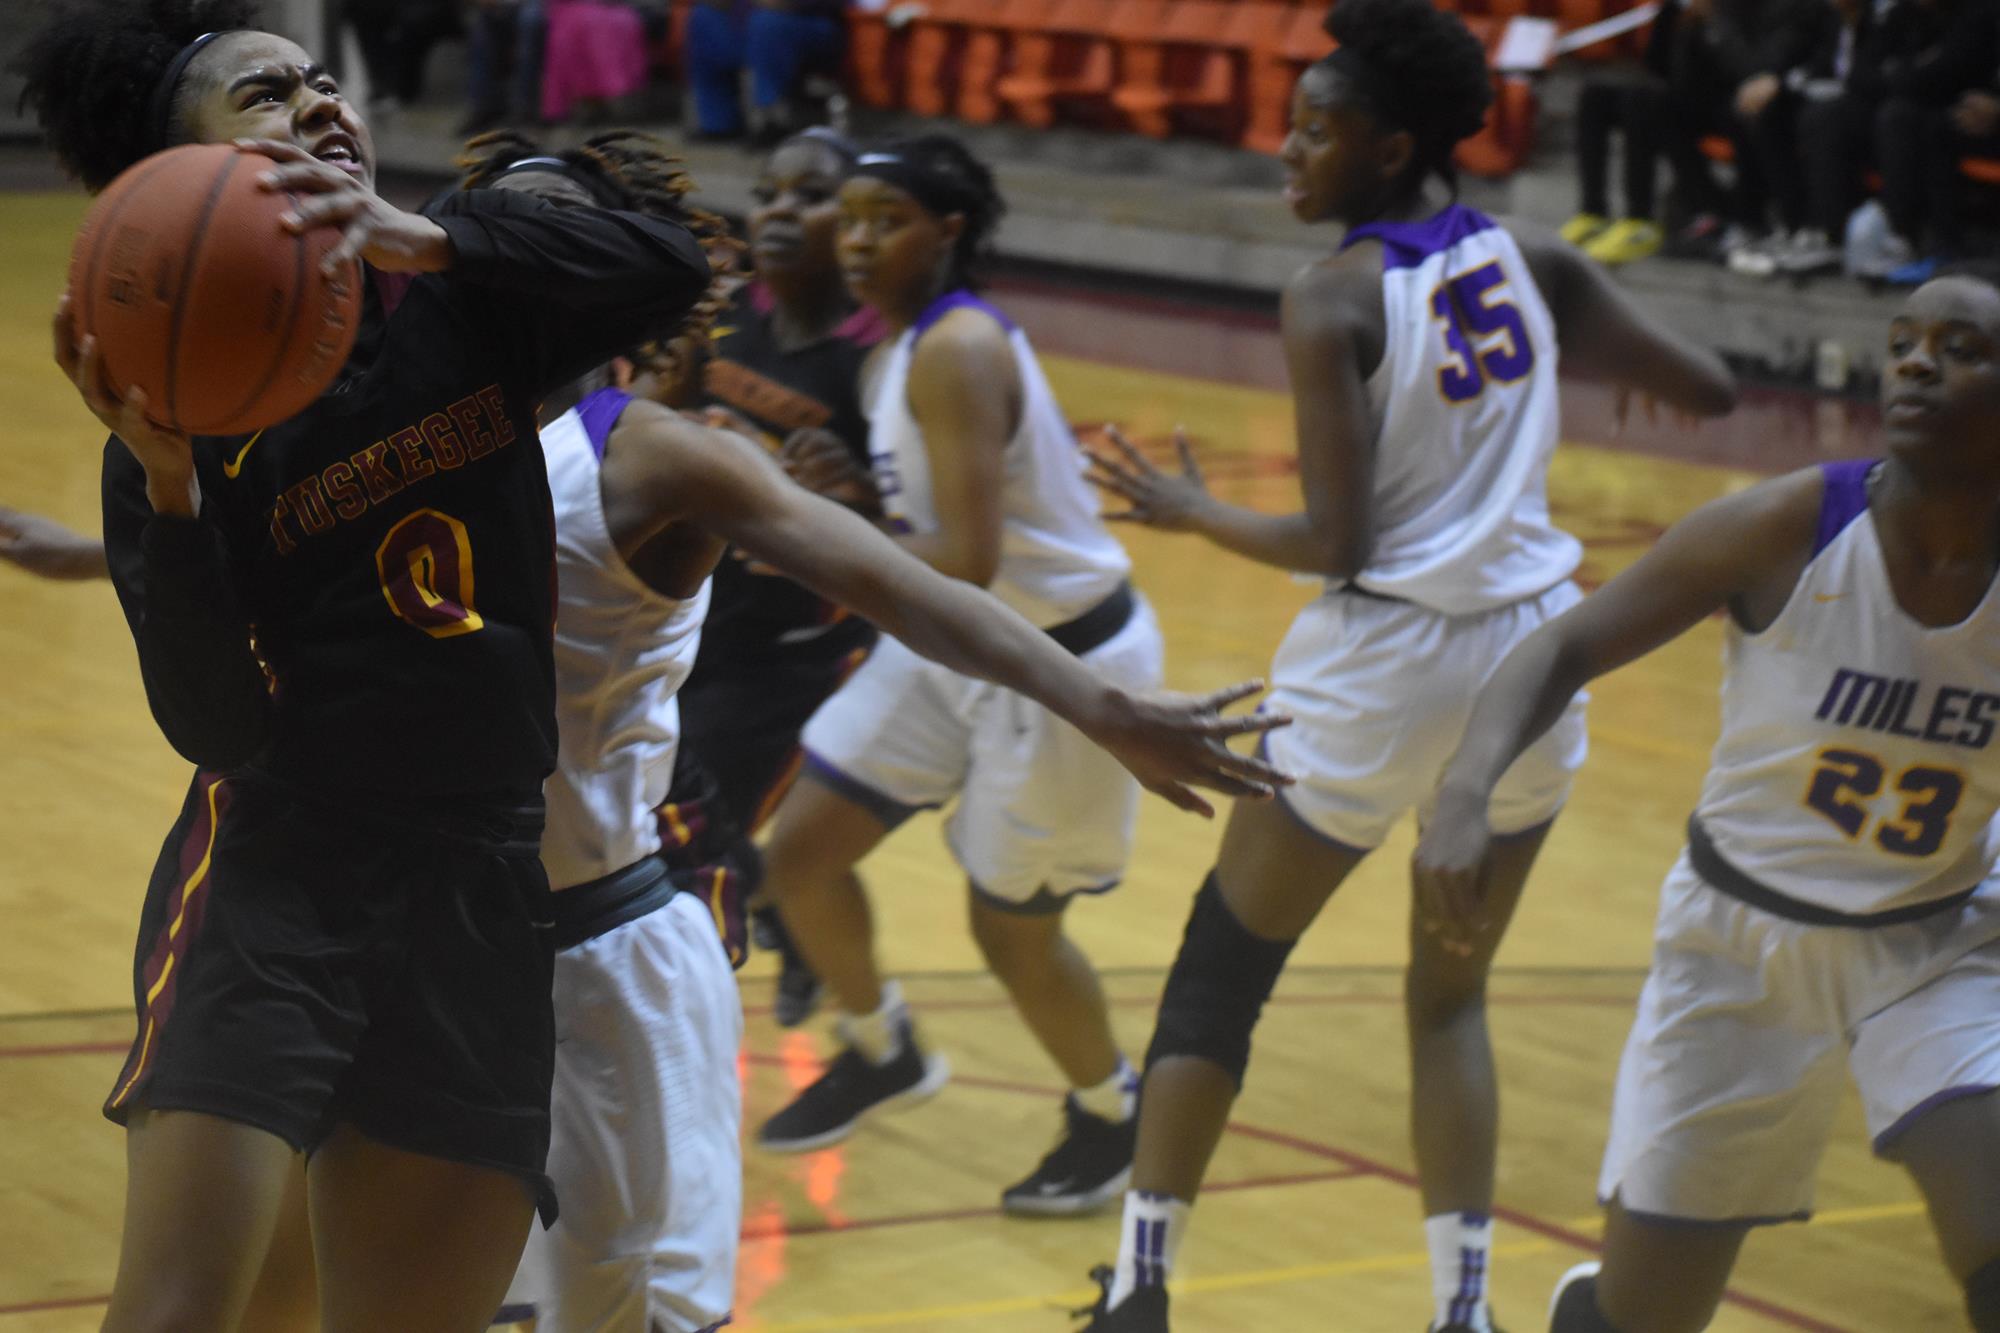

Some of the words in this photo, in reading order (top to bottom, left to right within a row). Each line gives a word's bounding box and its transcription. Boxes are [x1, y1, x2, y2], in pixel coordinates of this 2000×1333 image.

[1429, 257, 1535, 406] 35
[269, 383, 516, 555] TUSKEGEE
[375, 507, 485, 638] 0
[1815, 667, 2000, 748] MILES
[1805, 748, 1964, 858] 23
